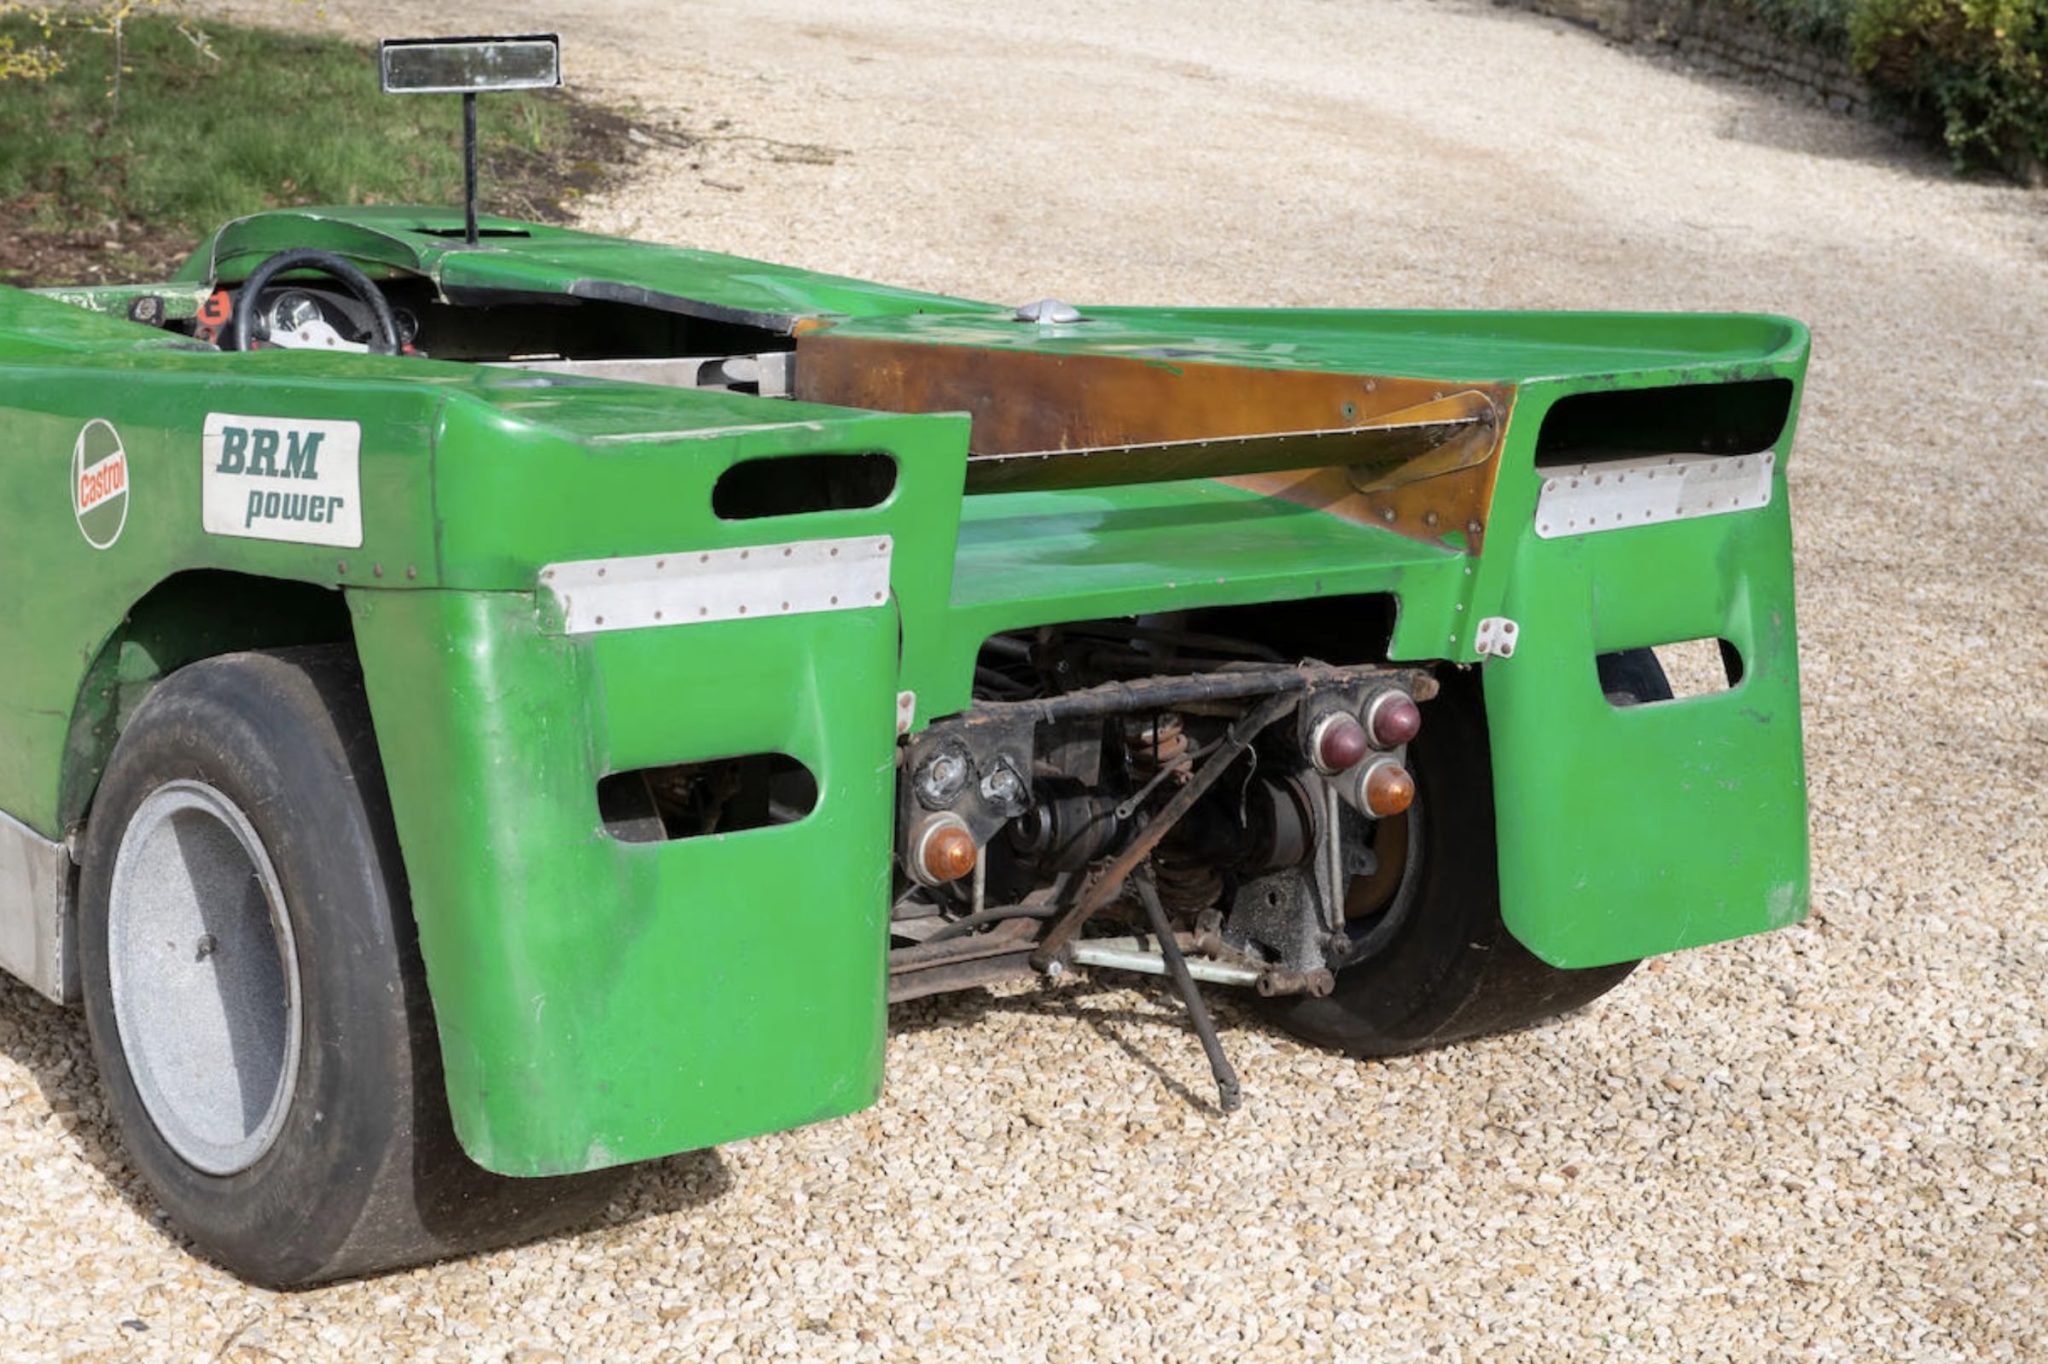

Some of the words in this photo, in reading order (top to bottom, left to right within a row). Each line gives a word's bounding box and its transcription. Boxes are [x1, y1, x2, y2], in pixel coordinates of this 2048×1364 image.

[216, 426, 325, 480] BRM
[81, 455, 124, 507] Castrol
[245, 490, 344, 528] power
